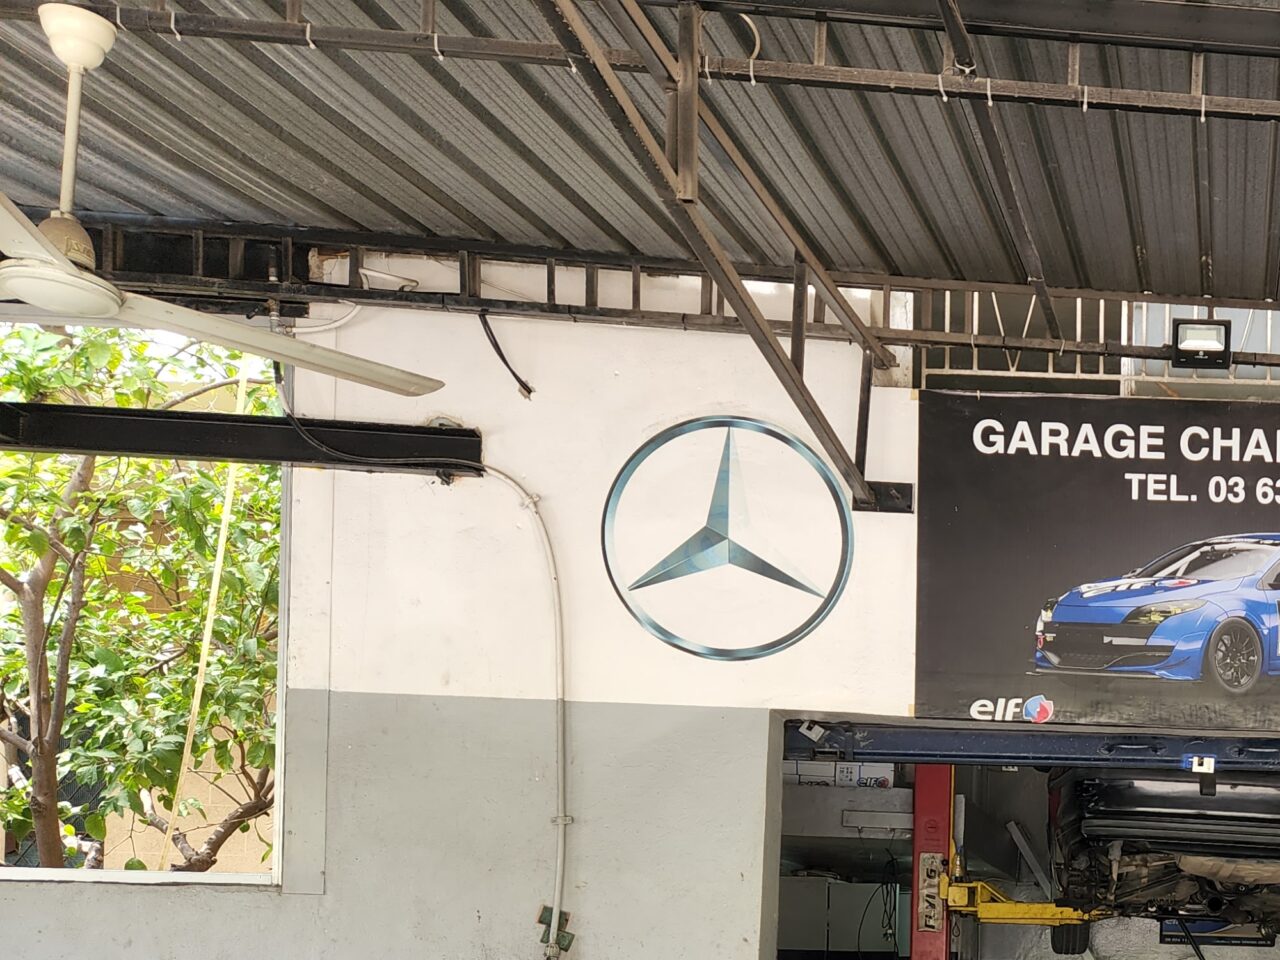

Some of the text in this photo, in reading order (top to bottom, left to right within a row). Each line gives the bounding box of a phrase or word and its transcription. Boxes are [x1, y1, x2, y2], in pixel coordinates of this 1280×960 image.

[972, 418, 1166, 460] GARAGE
[1124, 472, 1198, 502] TEL.
[1208, 475, 1246, 504] 03
[969, 698, 1023, 721] elf
[924, 867, 937, 930] FLYIG
